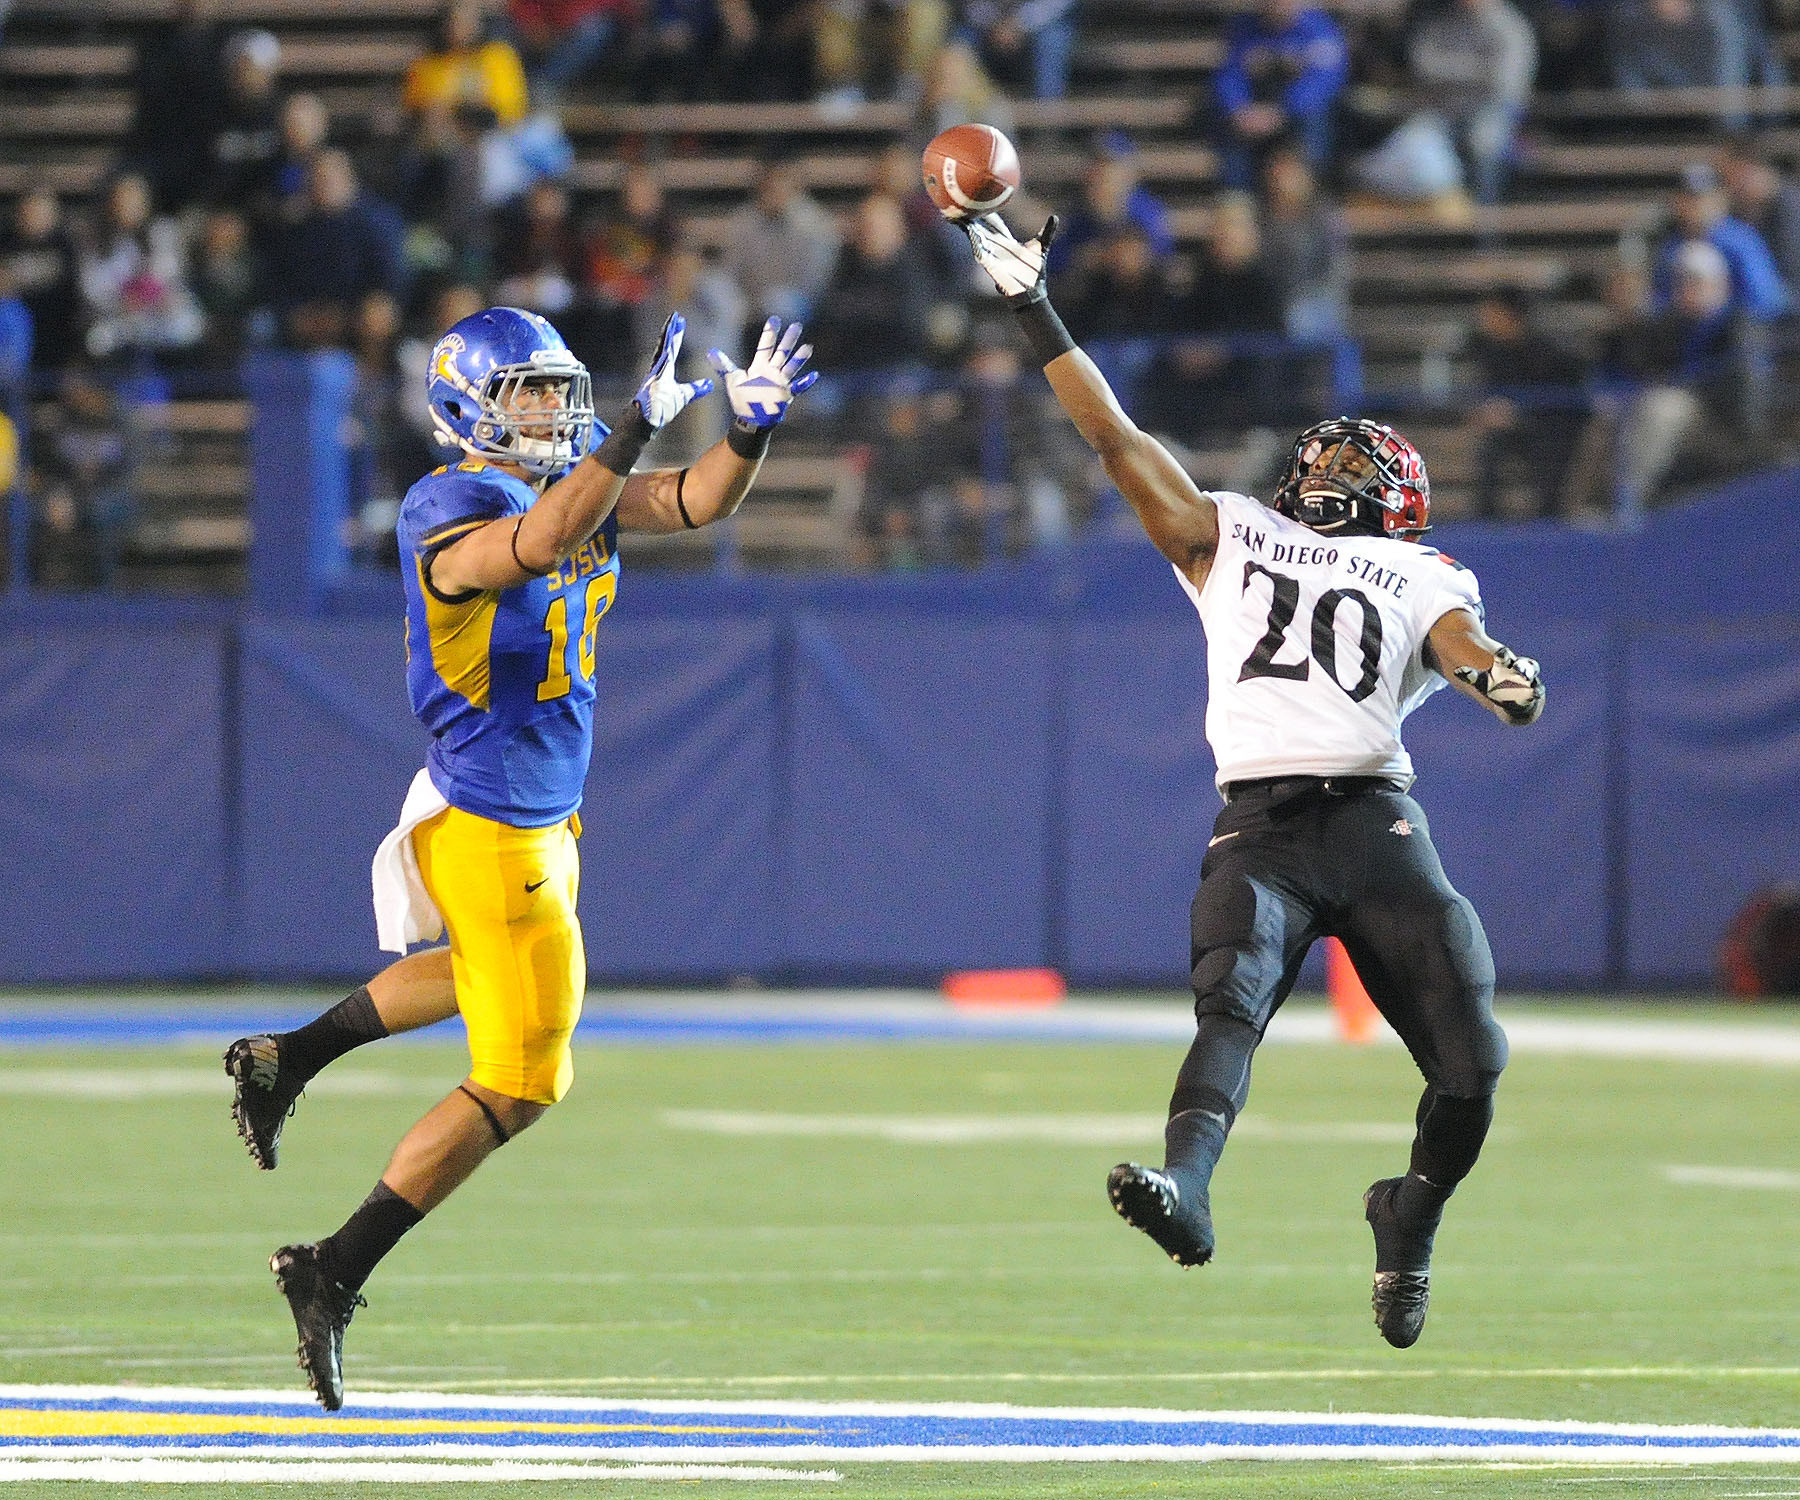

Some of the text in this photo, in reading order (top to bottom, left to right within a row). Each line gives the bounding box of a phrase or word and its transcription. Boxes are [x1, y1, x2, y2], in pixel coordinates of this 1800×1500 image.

[546, 532, 609, 592] SJSU
[1231, 523, 1409, 599] SAN DIEGO STATE
[535, 570, 617, 702] 18
[1236, 559, 1383, 704] 20
